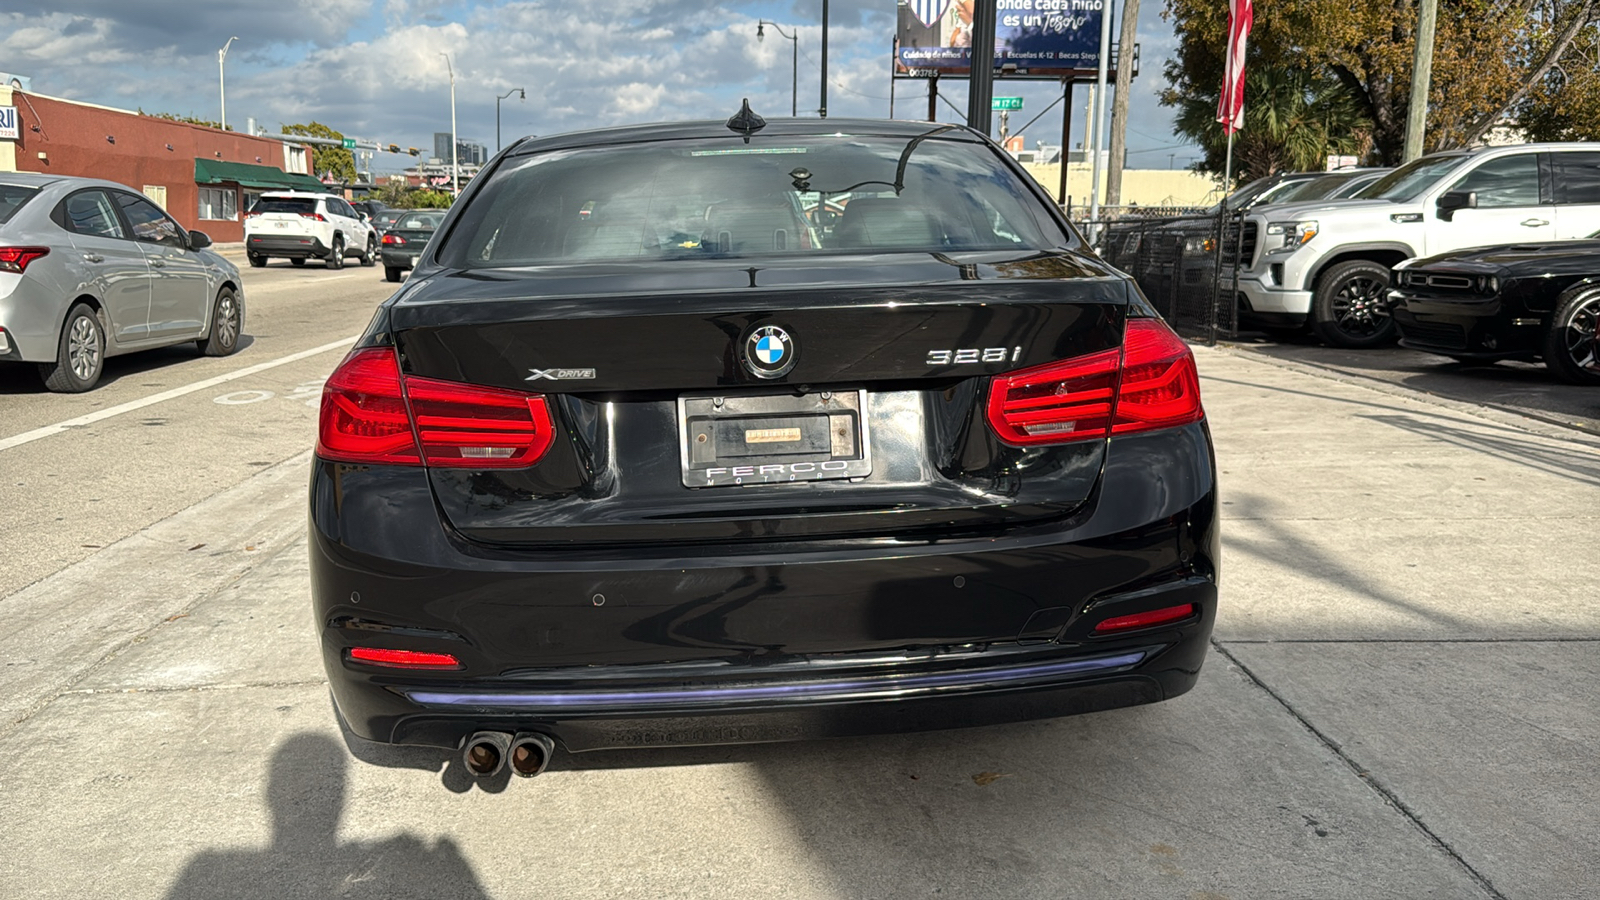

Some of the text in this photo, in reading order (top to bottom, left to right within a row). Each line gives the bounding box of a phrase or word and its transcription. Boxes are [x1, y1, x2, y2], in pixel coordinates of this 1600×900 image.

[1034, 0, 1068, 10] cada
[1003, 11, 1087, 33] es un Tesoro
[903, 50, 931, 59] Cuidado
[932, 49, 941, 59] de
[1007, 51, 1037, 59] Escuelas
[1058, 52, 1080, 60] Becas
[1080, 52, 1096, 61] Step
[1002, 99, 1010, 108] 17
[751, 327, 789, 343] BMW
[925, 345, 1022, 365] 328i
[706, 460, 848, 478] FERCO
[707, 471, 849, 486] MOTORS
